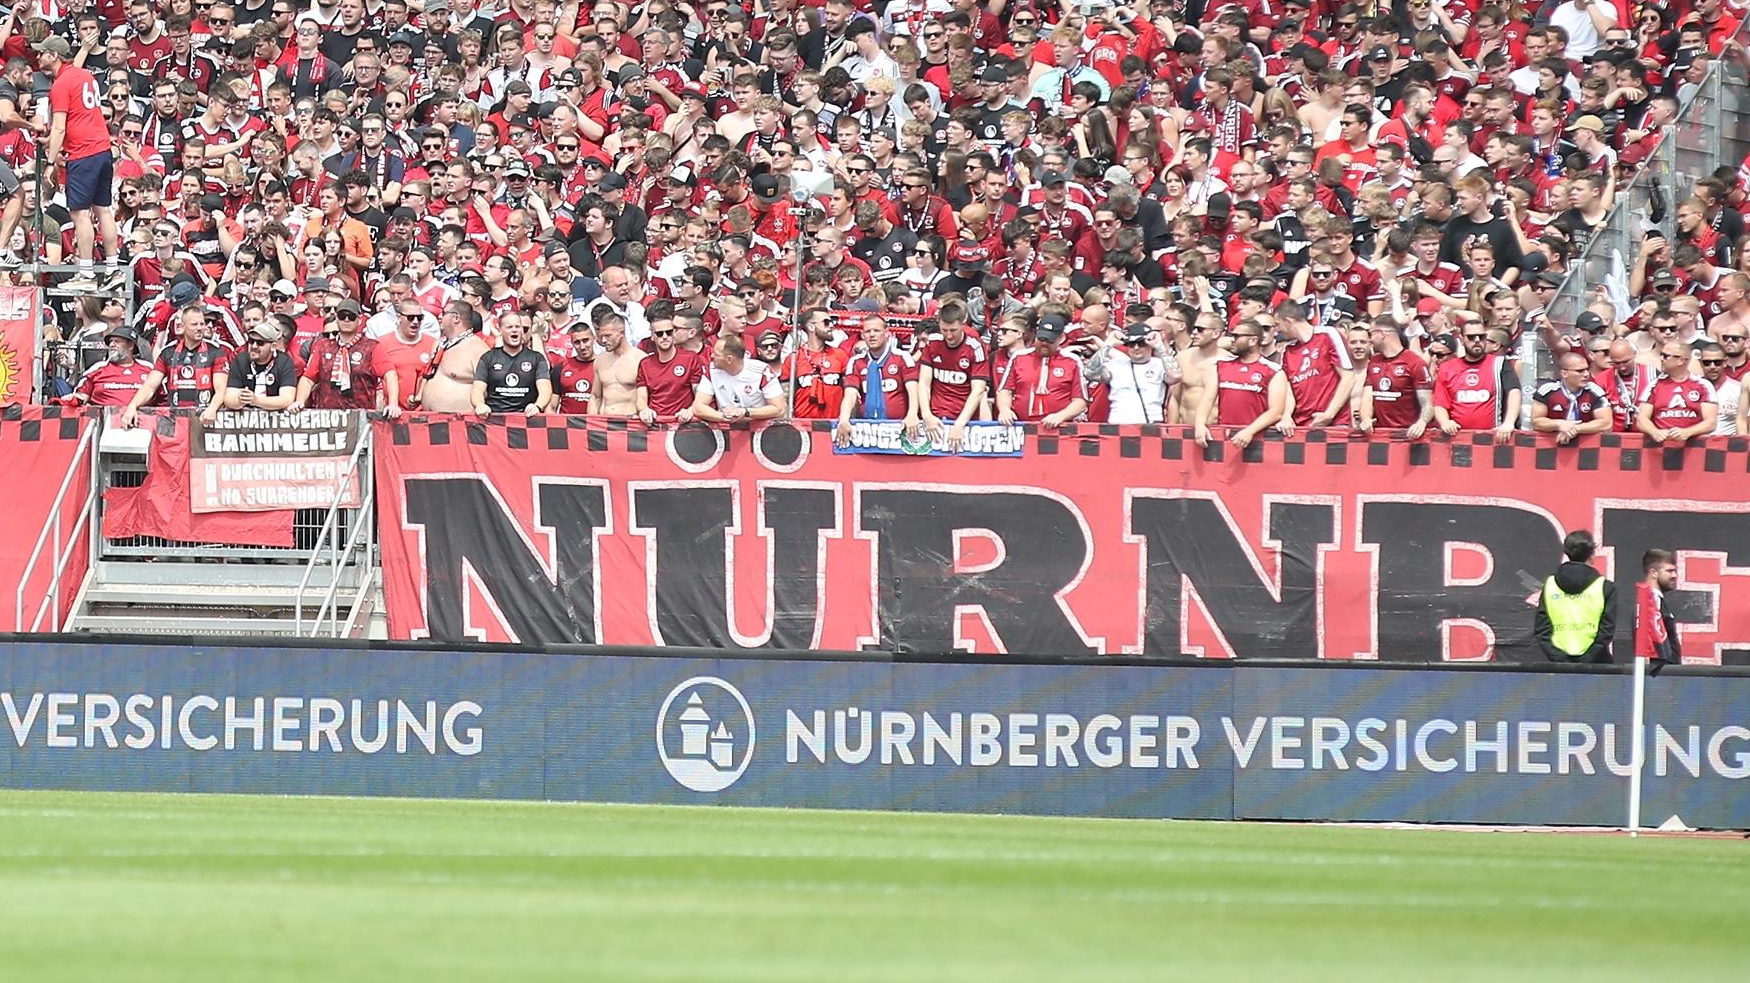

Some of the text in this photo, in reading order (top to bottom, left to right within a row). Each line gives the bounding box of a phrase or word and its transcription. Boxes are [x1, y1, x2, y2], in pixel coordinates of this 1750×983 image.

[934, 368, 967, 384] NKD
[1456, 389, 1489, 403] ARO
[204, 431, 348, 452] BANNMEILE
[832, 422, 902, 450] UNGE
[221, 463, 336, 481] DURCHHALTEN
[221, 488, 242, 505] NO
[0, 691, 484, 756] VERSICHERUNG
[786, 705, 1201, 769] NÜRNBERGER
